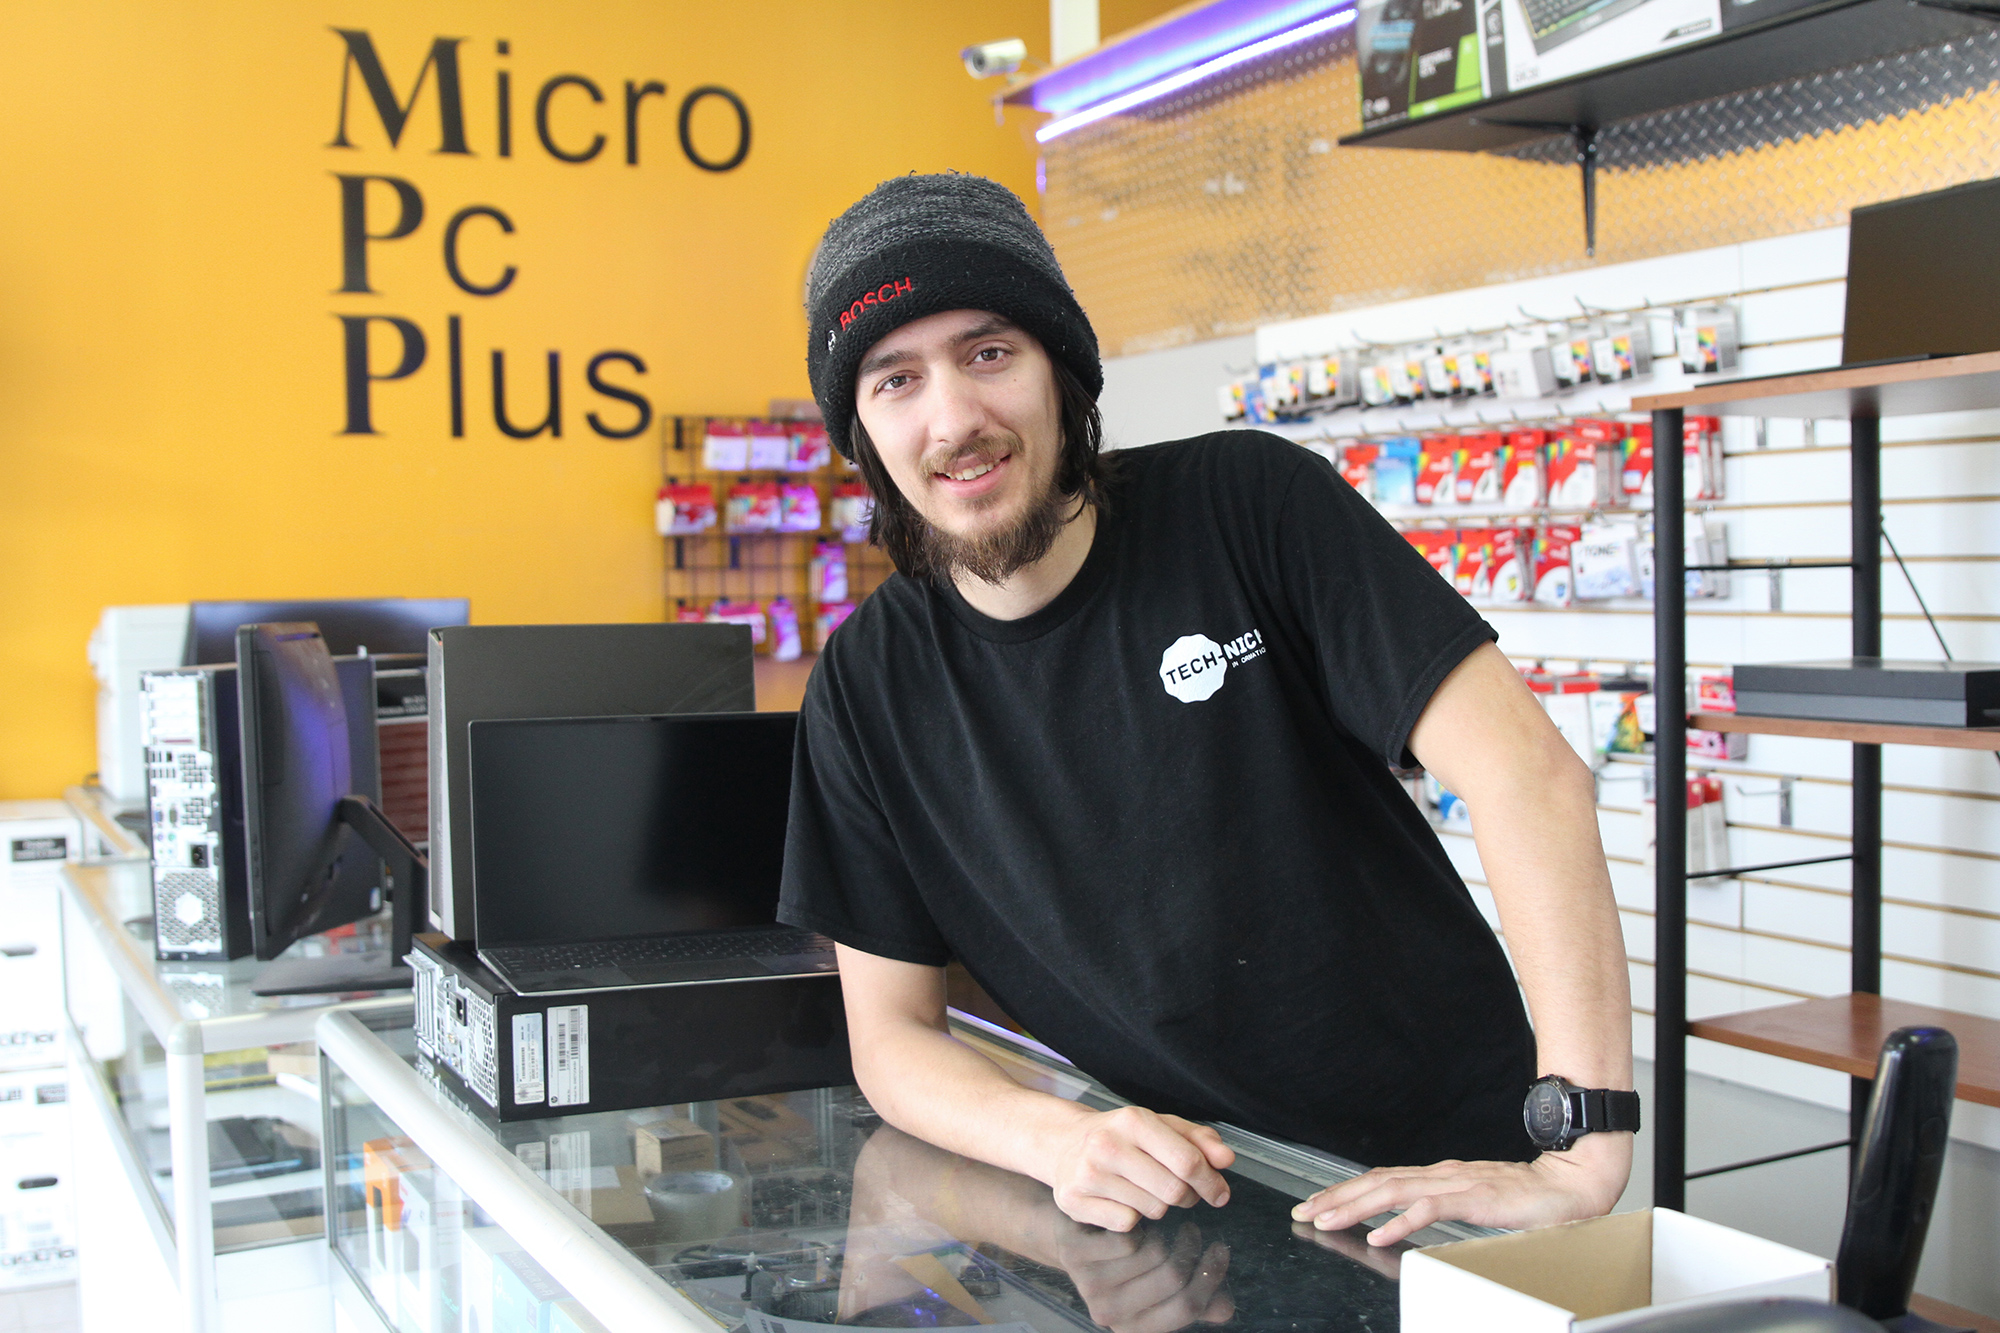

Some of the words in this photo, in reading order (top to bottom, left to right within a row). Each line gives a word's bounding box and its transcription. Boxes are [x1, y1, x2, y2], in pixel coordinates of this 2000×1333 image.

[324, 26, 753, 173] Micro
[327, 171, 518, 297] Pc
[839, 276, 913, 331] BOSCH
[329, 313, 653, 439] Plus
